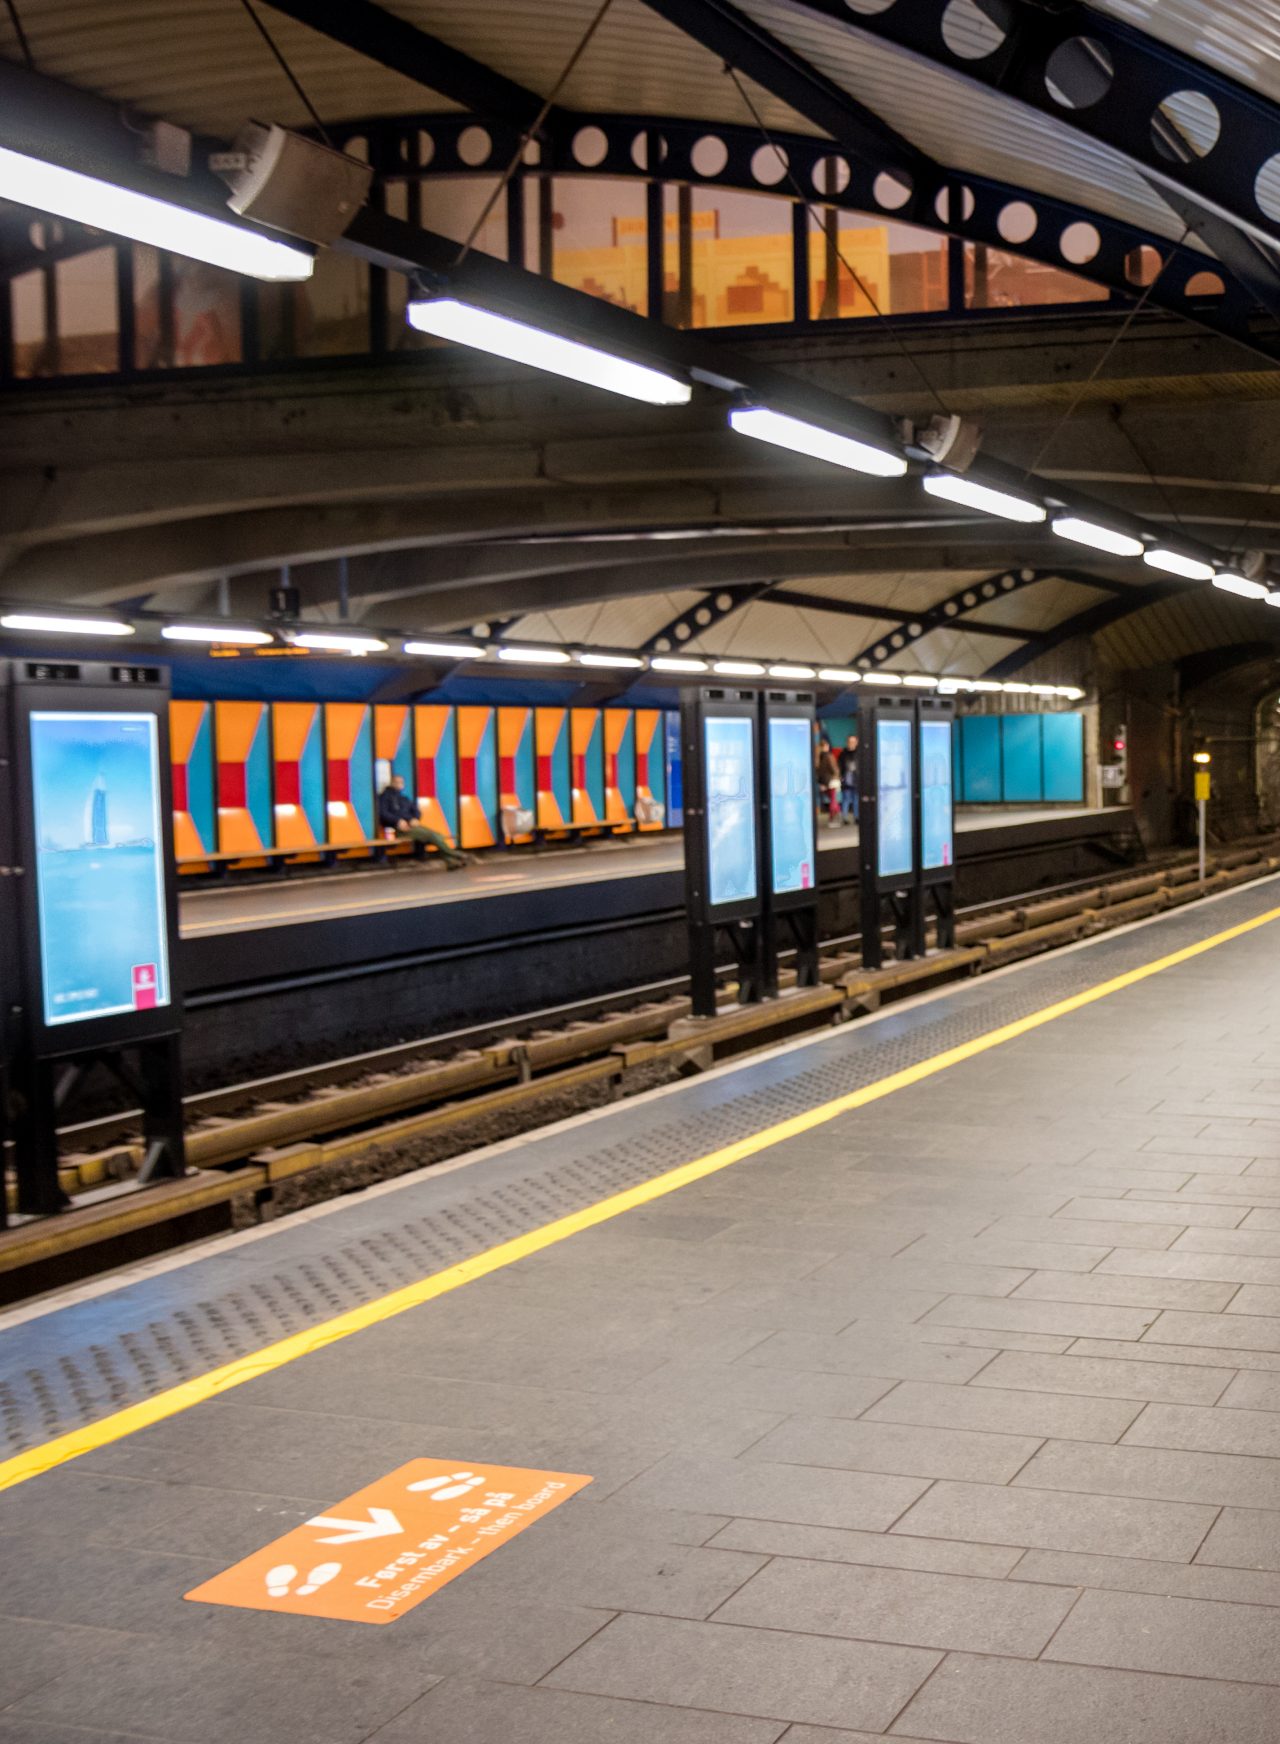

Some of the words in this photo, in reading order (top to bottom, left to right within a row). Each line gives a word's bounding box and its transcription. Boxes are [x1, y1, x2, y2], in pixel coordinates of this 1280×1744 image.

[354, 1550, 427, 1588] Først
[418, 1533, 450, 1550] av
[458, 1507, 493, 1524] så
[482, 1491, 516, 1508] på
[365, 1546, 474, 1610] Disembark
[476, 1505, 524, 1536] then
[511, 1480, 567, 1511] board
